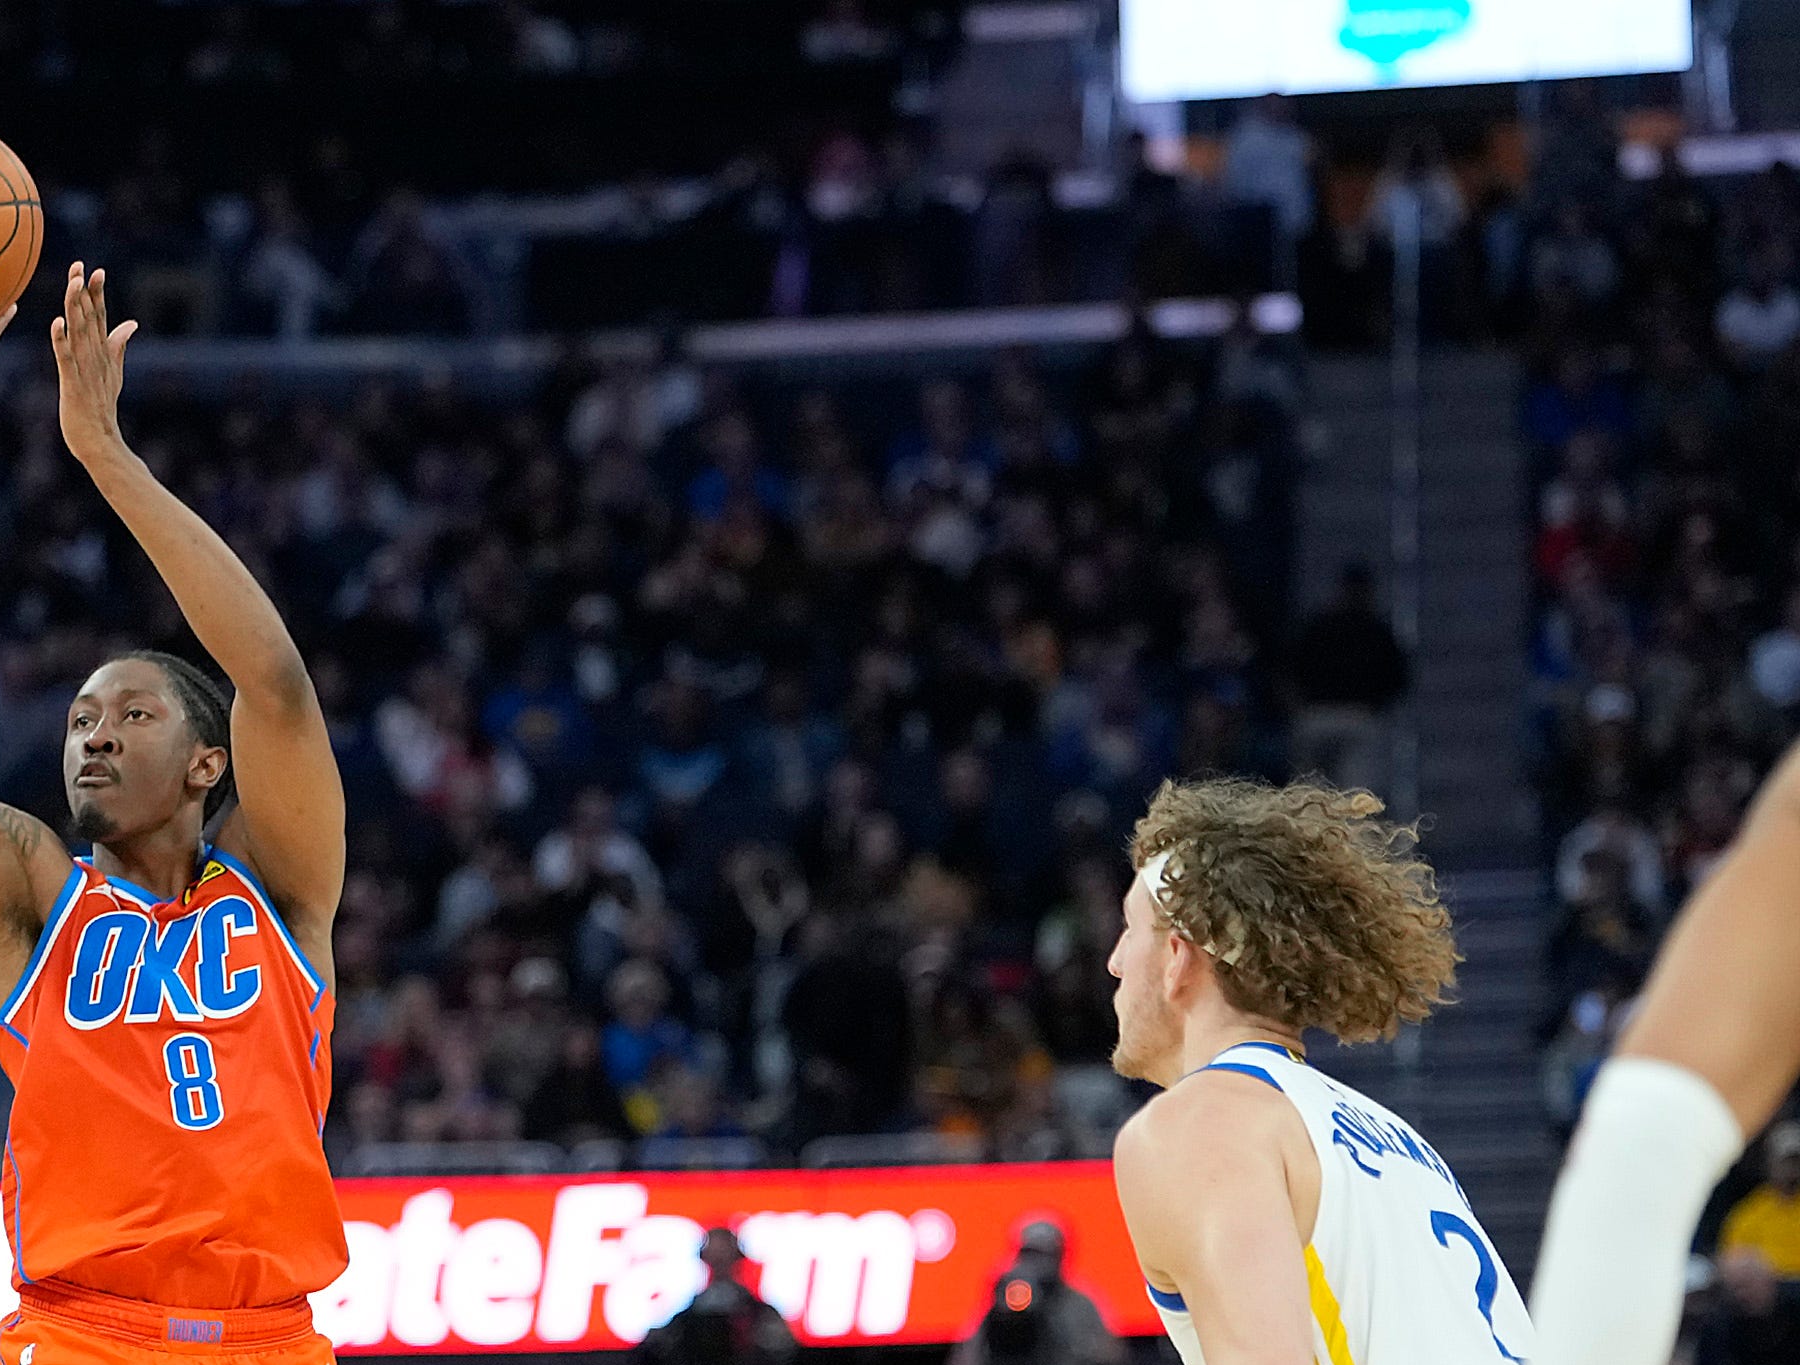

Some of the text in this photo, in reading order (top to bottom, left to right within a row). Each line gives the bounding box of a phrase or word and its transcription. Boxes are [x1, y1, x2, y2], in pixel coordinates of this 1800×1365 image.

[64, 895, 262, 1030] OKC
[162, 1031, 224, 1132] 8
[167, 1317, 223, 1343] THUNDER
